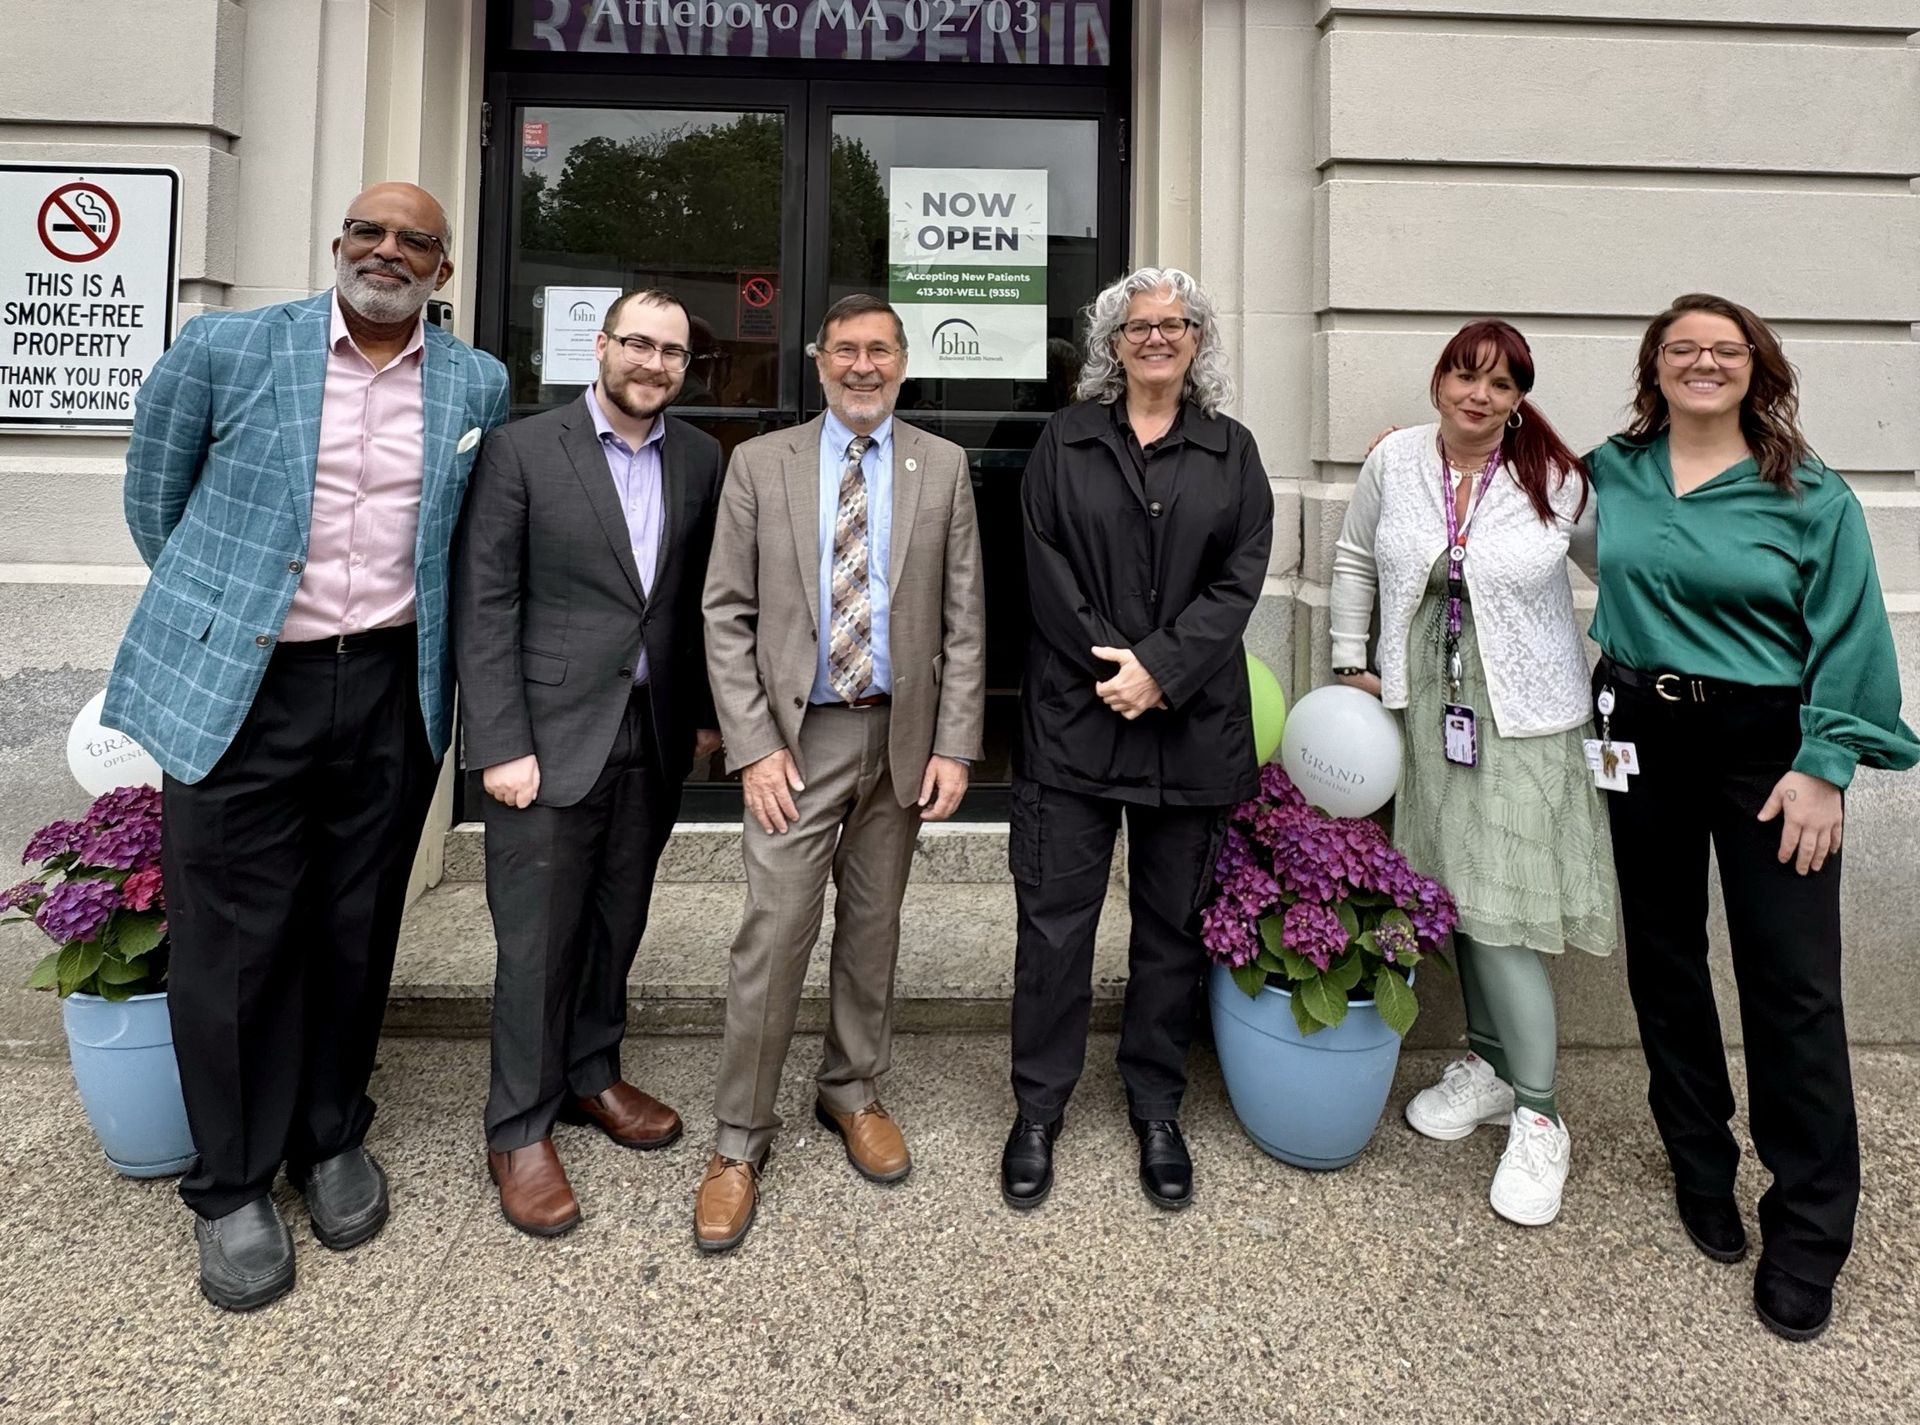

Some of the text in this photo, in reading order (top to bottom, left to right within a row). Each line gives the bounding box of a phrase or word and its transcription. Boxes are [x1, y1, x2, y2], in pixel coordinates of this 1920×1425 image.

[591, 0, 1038, 33] Attleboro MA 02703
[922, 192, 1017, 218] NOW
[917, 225, 1019, 251] OPEN
[25, 272, 126, 298] THIS IS A
[906, 272, 1030, 283] Accepting New Patients
[916, 287, 1020, 299] 413-301-WELL (9355)
[4, 302, 144, 328] SMOKE-FREE
[573, 308, 596, 322] bhn
[13, 332, 131, 357] PROPERTY
[940, 332, 981, 355] bhn
[0, 366, 143, 387] THANK YOU FOR
[9, 390, 130, 410] NOT SMOKING
[103, 749, 147, 768] OPENI
[1302, 751, 1365, 784] GRAND
